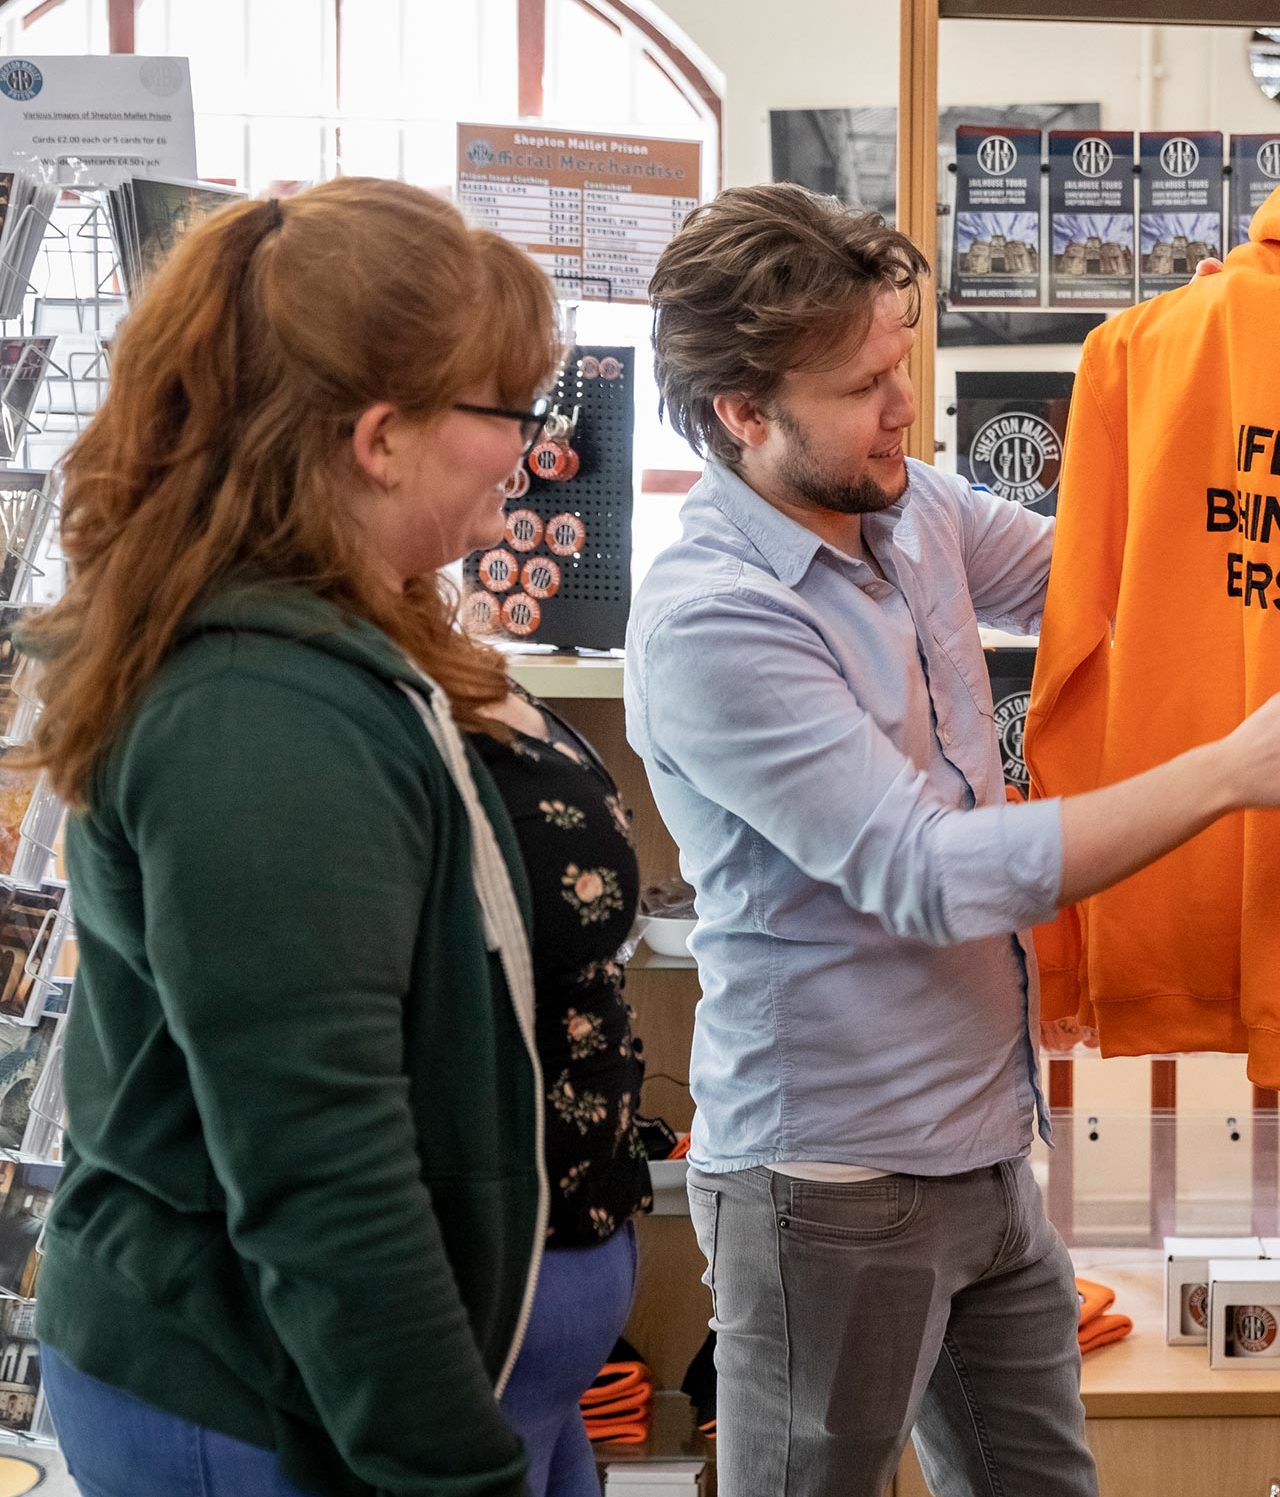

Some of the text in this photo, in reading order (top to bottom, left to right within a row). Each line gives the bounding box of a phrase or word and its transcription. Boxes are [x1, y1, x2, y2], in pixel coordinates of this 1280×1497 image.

[82, 111, 90, 119] of
[124, 112, 147, 120] Mallet
[32, 136, 55, 144] Cards
[82, 136, 100, 144] each
[120, 136, 141, 144] cards
[143, 136, 154, 145] for
[513, 133, 648, 155] Shepton Mallet Prison
[560, 155, 685, 180] Merchandise
[975, 417, 1060, 462] SHEPTON MALLET
[992, 480, 1046, 502] PRISON
[1003, 760, 1027, 780] PRI
